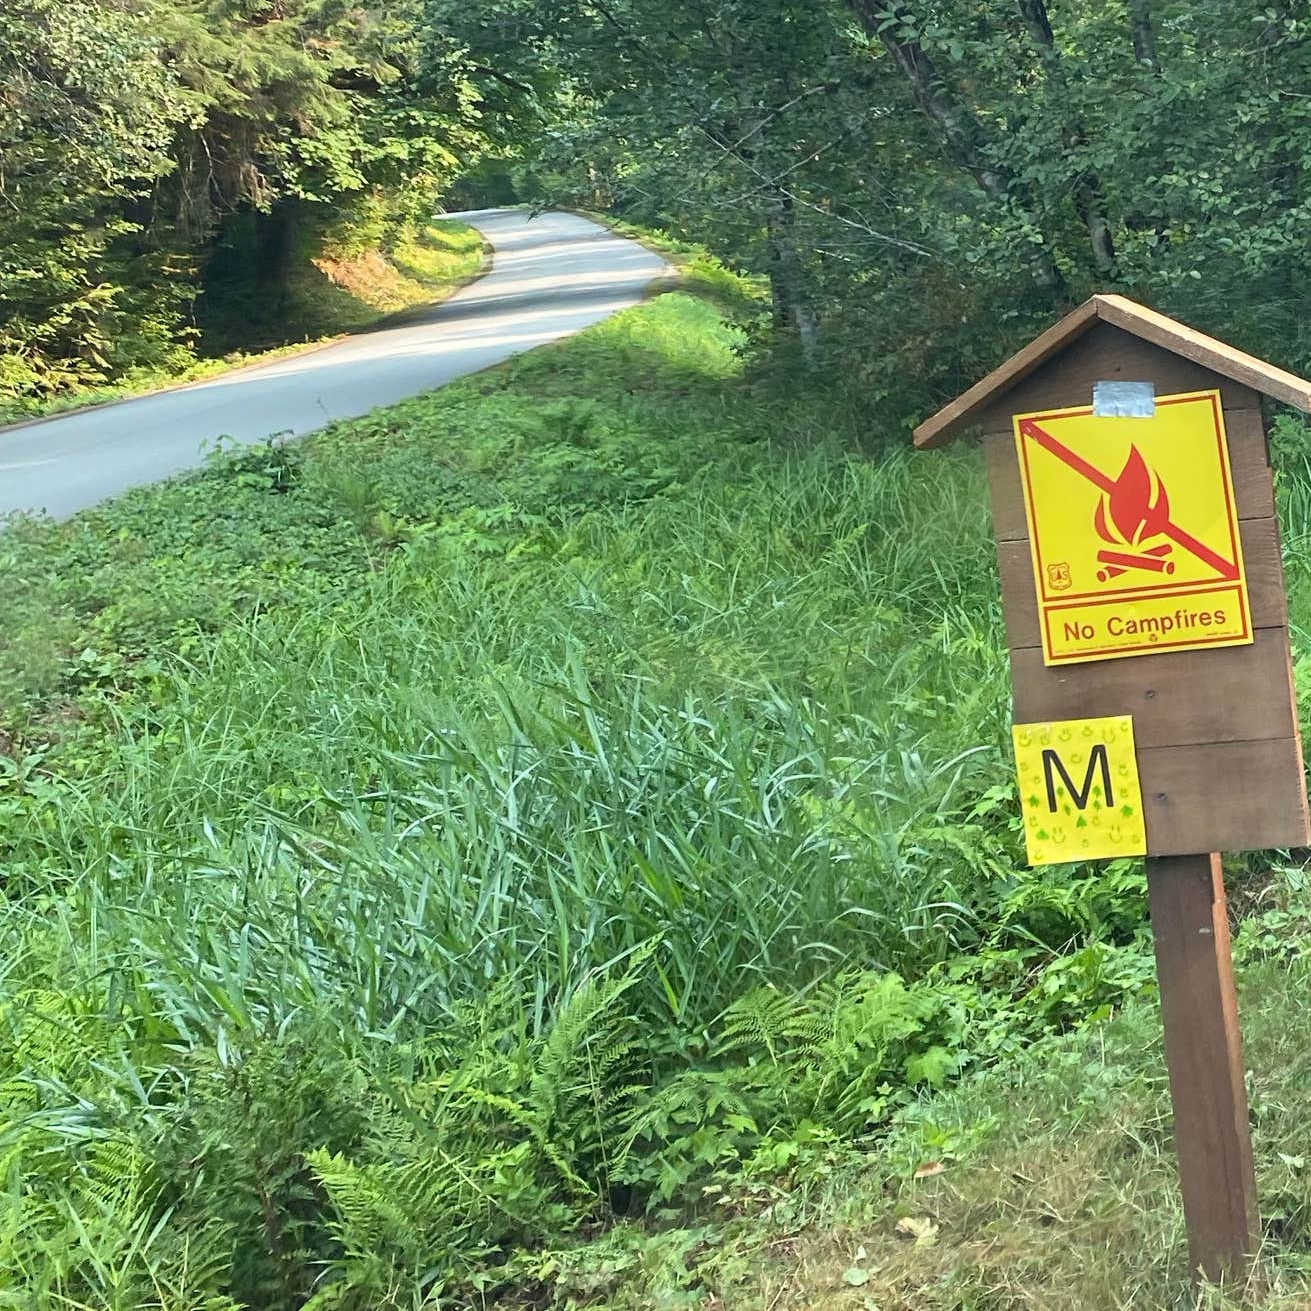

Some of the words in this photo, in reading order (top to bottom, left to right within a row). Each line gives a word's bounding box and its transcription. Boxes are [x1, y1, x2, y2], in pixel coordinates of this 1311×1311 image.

[1063, 622, 1095, 641] No
[1107, 609, 1226, 635] Campfires
[1041, 744, 1114, 813] M
